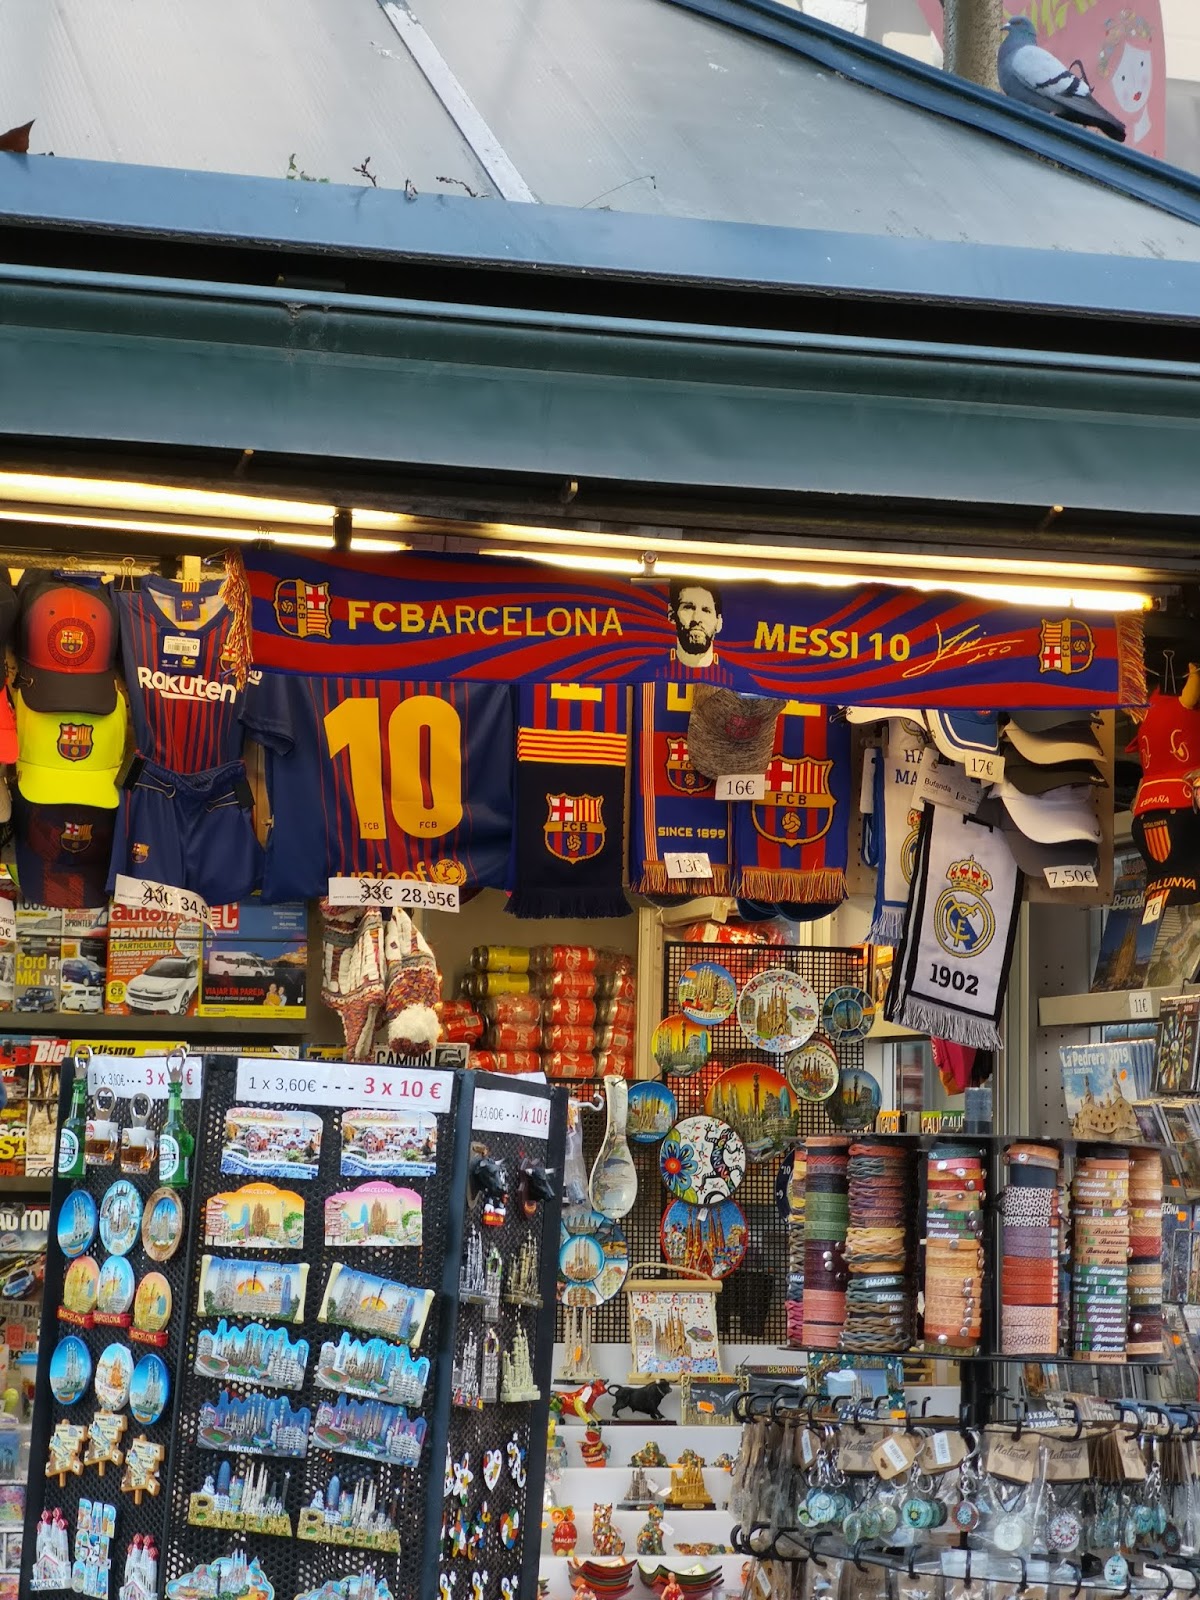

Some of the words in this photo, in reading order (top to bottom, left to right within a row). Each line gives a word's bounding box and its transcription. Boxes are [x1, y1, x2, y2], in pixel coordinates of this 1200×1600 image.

[753, 620, 859, 660] MESSI
[869, 632, 911, 663] 10
[137, 666, 237, 704] Rakuten
[323, 694, 464, 840] 10
[971, 757, 994, 776] 17€
[726, 779, 755, 796] 16€
[924, 777, 952, 793] Bufanda
[775, 793, 807, 806] FCB
[363, 821, 380, 831] FCB
[419, 820, 438, 830] FCB
[561, 822, 588, 833] FCB
[657, 826, 693, 838] SINCE
[696, 827, 726, 840] 1899
[1048, 869, 1094, 885] 7,50€
[401, 887, 456, 908] 28,95€
[1145, 901, 1160, 920] 7€
[118, 941, 172, 950] PARTICULARES
[16, 953, 48, 969] Ford
[929, 962, 980, 996] 1902
[205, 987, 229, 996] VIAJAR
[229, 987, 239, 996] EN
[240, 987, 265, 996] PAREJA
[1134, 998, 1149, 1013] 11€
[1072, 1048, 1106, 1067] Pedrera
[145, 1069, 154, 1086] 3
[158, 1072, 165, 1085] x
[248, 1076, 257, 1091] 1
[261, 1080, 271, 1090] x
[275, 1077, 318, 1094] 3,60€
[363, 1076, 376, 1095] 3
[381, 1080, 393, 1097] x
[399, 1078, 424, 1099] 10
[428, 1081, 442, 1100] €
[241, 1188, 277, 1196] BARCELONA
[358, 1186, 395, 1194] BARCELONA
[224, 1373, 260, 1384] BARCELONA
[344, 1386, 379, 1399] BARCELONA
[1147, 1411, 1169, 1427] 209
[228, 1444, 263, 1455] BARCELONA
[342, 1446, 376, 1459] BARCELONA
[993, 1443, 1030, 1461] Natural
